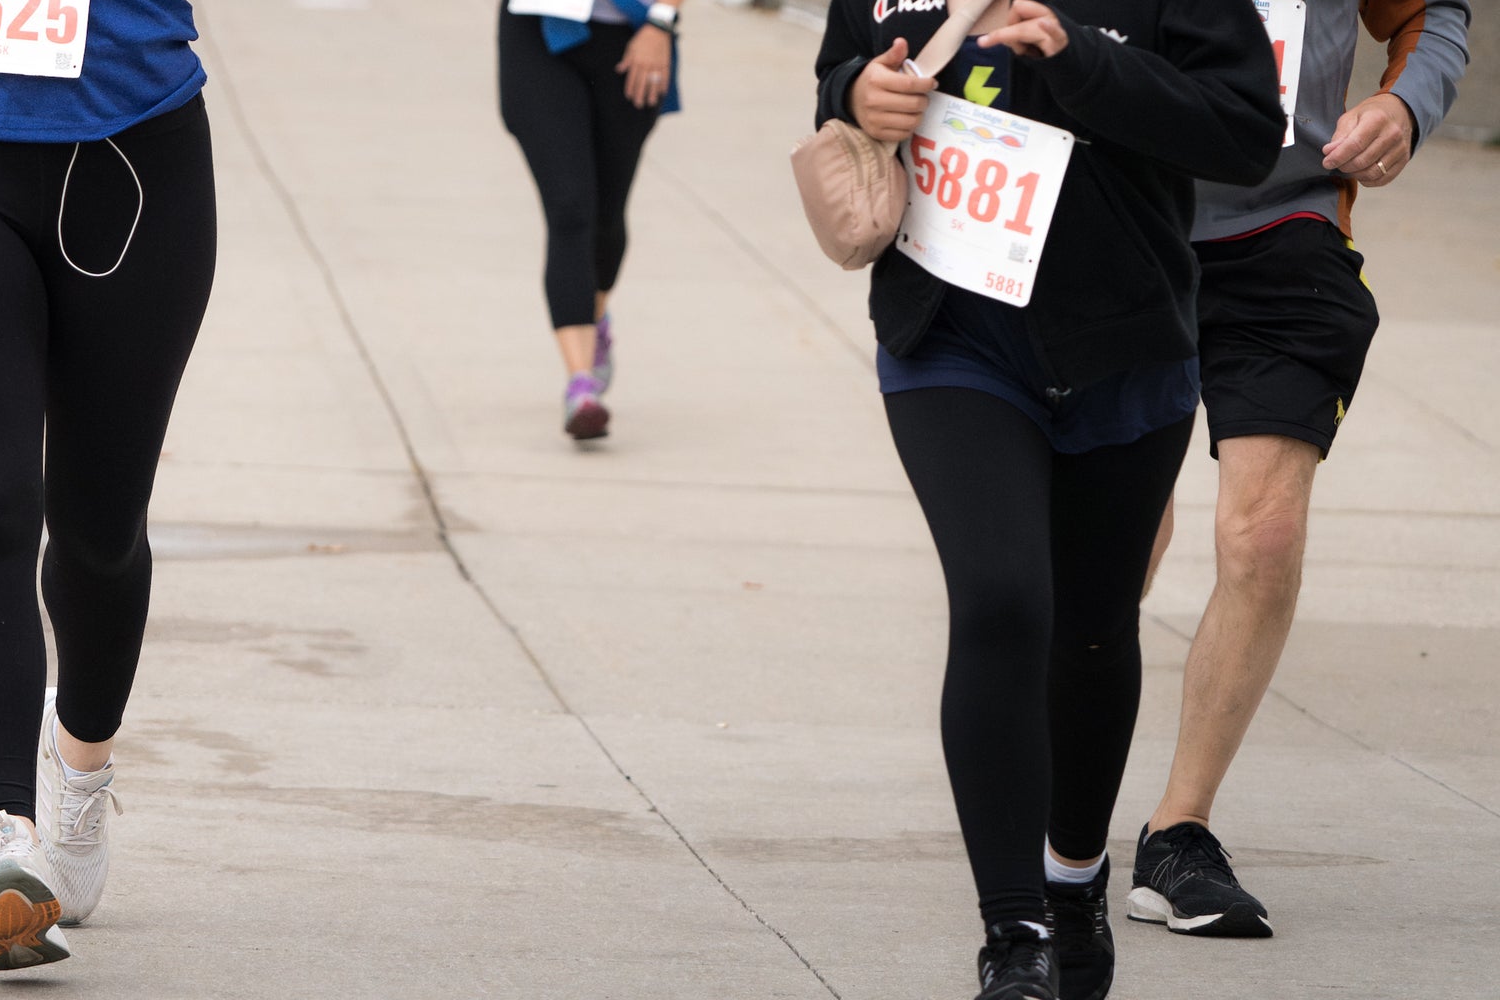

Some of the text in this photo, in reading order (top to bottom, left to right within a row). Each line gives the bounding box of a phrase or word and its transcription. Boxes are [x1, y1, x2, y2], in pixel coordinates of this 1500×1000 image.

[909, 135, 1040, 236] 5881
[950, 218, 966, 232] 5K
[984, 271, 1024, 298] 5881
